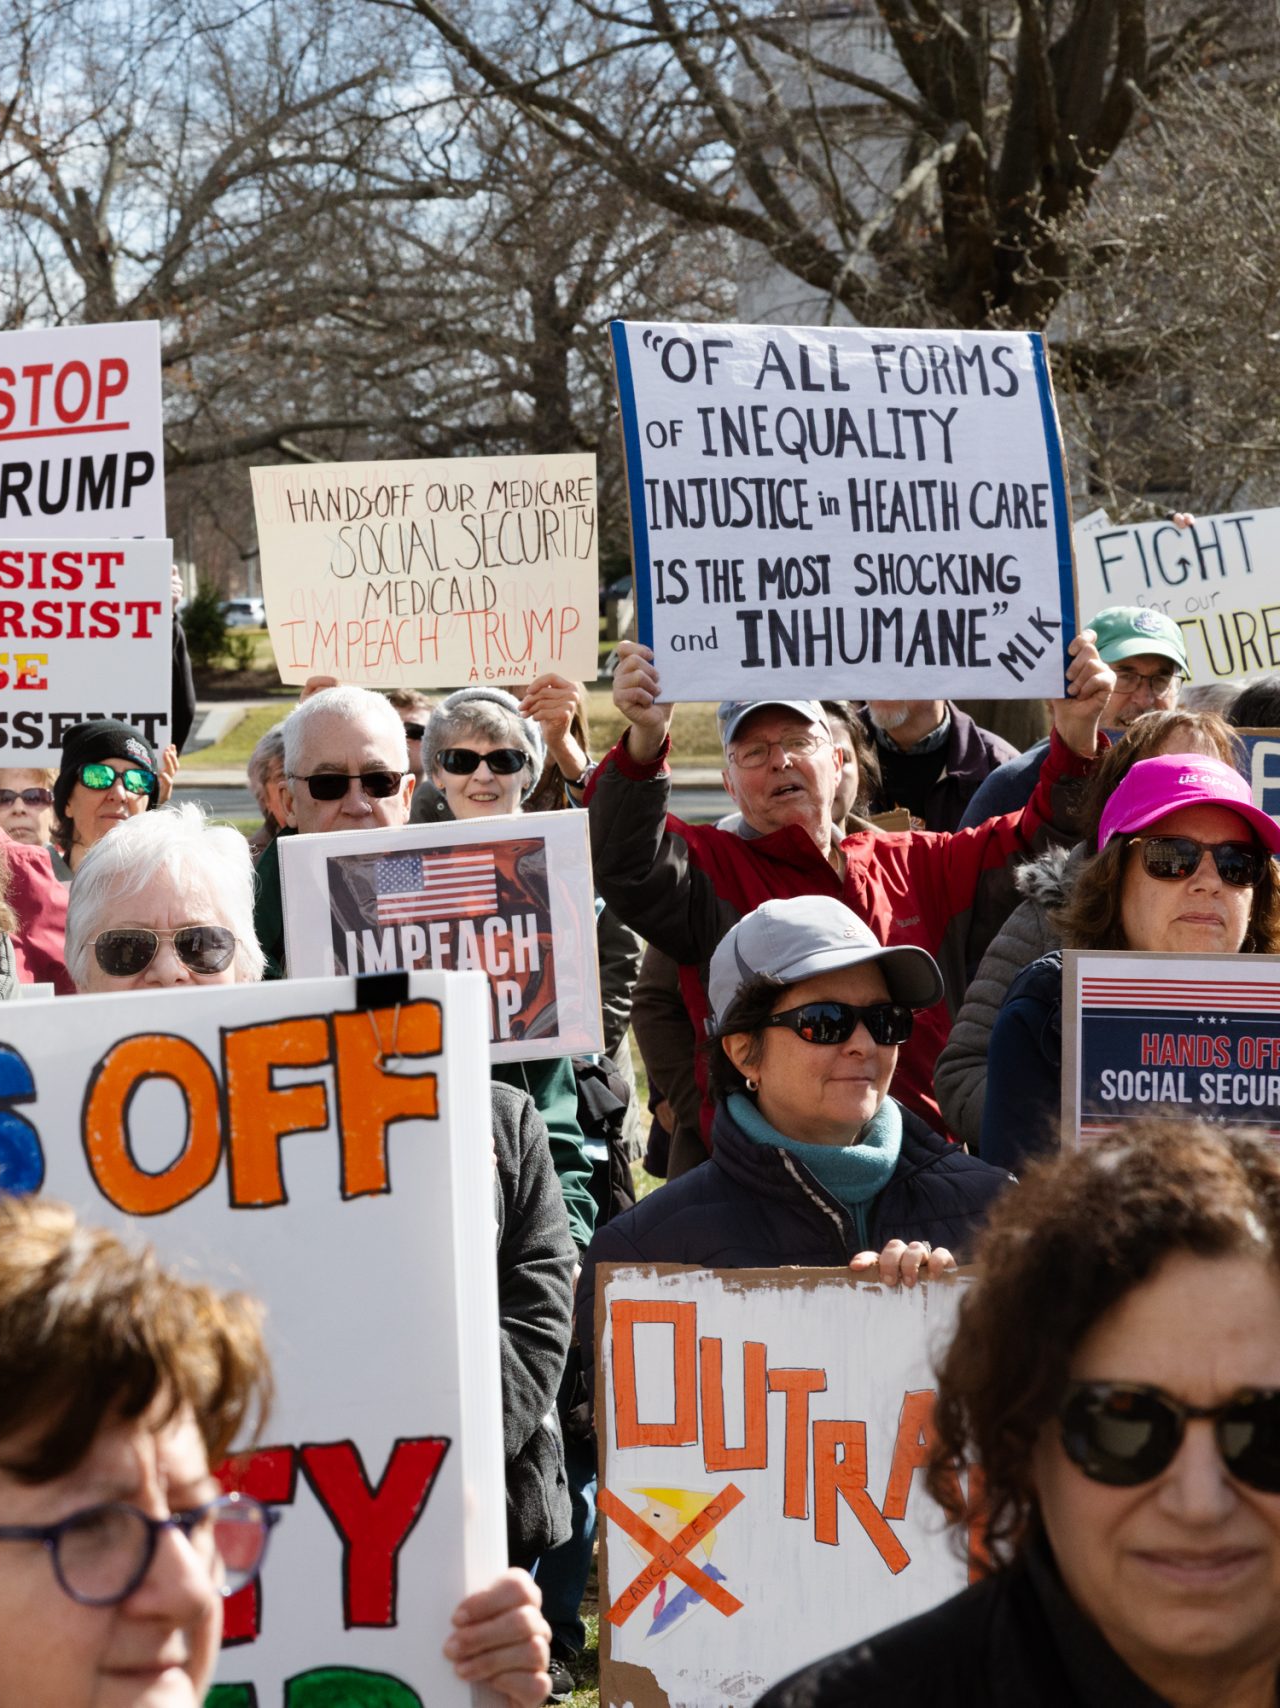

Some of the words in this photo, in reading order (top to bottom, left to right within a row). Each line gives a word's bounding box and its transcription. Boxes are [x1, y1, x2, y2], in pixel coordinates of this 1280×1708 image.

[753, 340, 850, 393] ALL
[871, 344, 1019, 398] FORMS
[645, 419, 683, 449] OF
[697, 405, 958, 464] INEQUALITY
[426, 483, 477, 512] OUR
[487, 477, 594, 511] MEDICARE
[645, 478, 813, 530] INJUSTICE
[817, 490, 840, 516] in
[848, 478, 960, 533] HEALTH
[969, 481, 1049, 530] CARE
[331, 518, 449, 578] SOCIAL
[455, 505, 595, 570] SECURITY
[1095, 516, 1255, 594] FIGHT
[362, 575, 497, 619] MEDICAID
[653, 559, 689, 605] IS
[696, 559, 746, 602] THE
[758, 554, 831, 601] MOST
[854, 552, 1021, 597] SHOCKING
[1185, 591, 1221, 613] our
[281, 616, 439, 669] IMPEACH
[454, 607, 580, 665] TRUMP
[670, 626, 719, 652] and
[996, 606, 1062, 683] MLK
[345, 913, 541, 977] IMPEACH
[1141, 1033, 1231, 1069] HANDS
[82, 998, 444, 1217] OFF
[1101, 1069, 1192, 1103] SOCIAL
[1200, 1074, 1280, 1107] SECUR
[618, 1504, 722, 1612] CANCELLED
